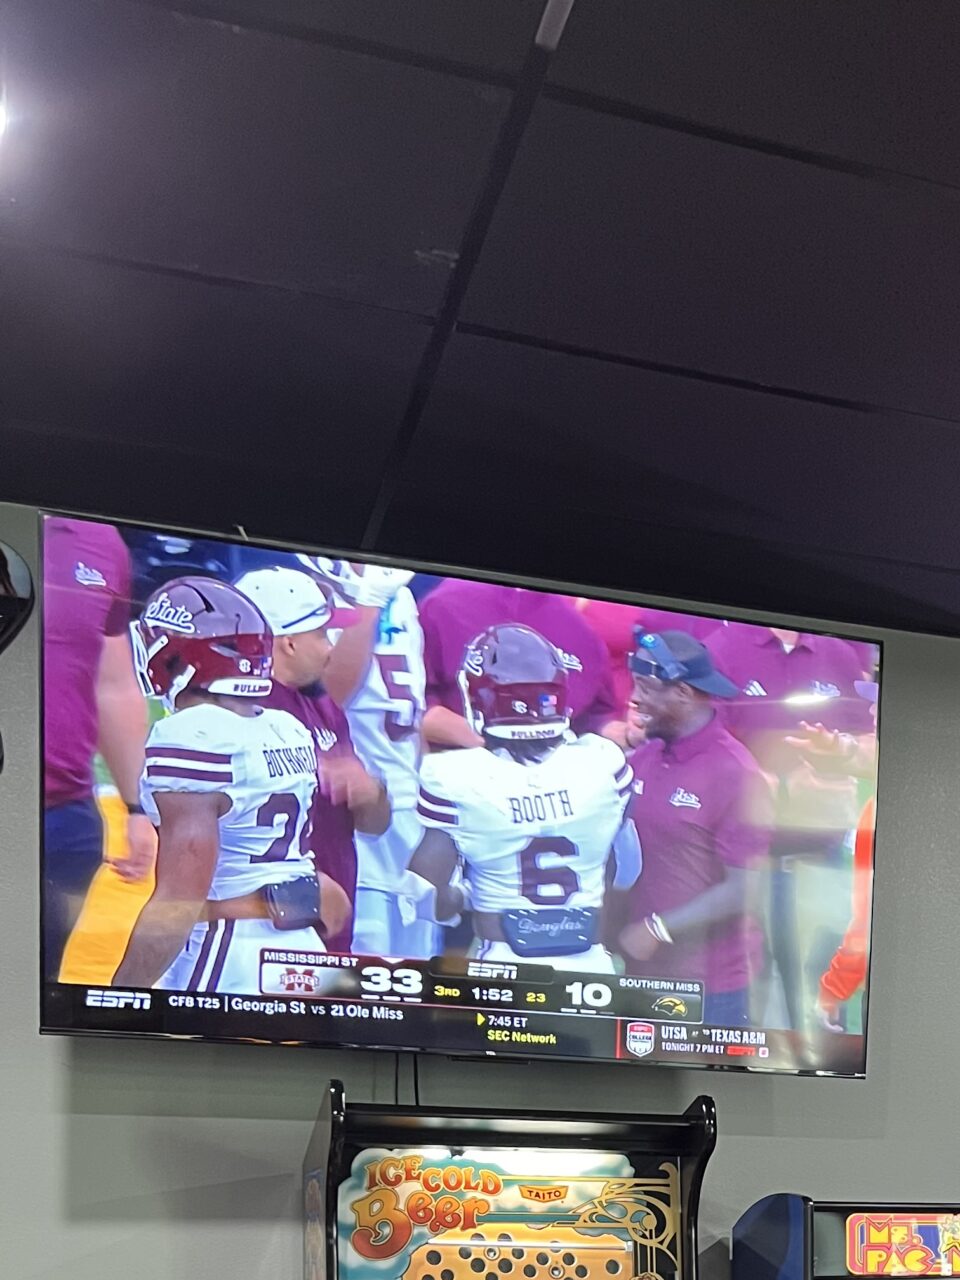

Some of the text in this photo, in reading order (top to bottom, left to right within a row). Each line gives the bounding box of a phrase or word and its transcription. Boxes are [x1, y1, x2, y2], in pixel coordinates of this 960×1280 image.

[145, 592, 195, 633] State
[509, 789, 574, 824] BOOTH
[520, 836, 579, 905] 6
[264, 951, 359, 967] MISSISSIPPI ST
[360, 966, 422, 993] 33
[467, 962, 518, 980] ESPN
[434, 985, 460, 998] 3RD
[472, 986, 513, 1002] 1:52
[565, 981, 612, 1007] 10
[619, 979, 700, 992] SOUTHERN MISS
[86, 990, 151, 1010] ESPN
[526, 992, 546, 1003] 23
[169, 995, 404, 1021] CFB T25 Georgia St vs 21 Ole Miss
[487, 1015, 528, 1028] 7:45 ET
[487, 1030, 557, 1044] SEC Network
[661, 1026, 688, 1040] UTSA
[711, 1028, 742, 1044] TEXAS
[742, 1031, 766, 1045] A&M
[661, 1041, 694, 1053] TONIGHT
[696, 1044, 701, 1053] 7
[702, 1044, 715, 1054] PM
[715, 1045, 725, 1055] ET
[364, 1155, 502, 1196] ICE COLD
[527, 1189, 562, 1200] TAITO
[350, 1187, 490, 1260] Beer
